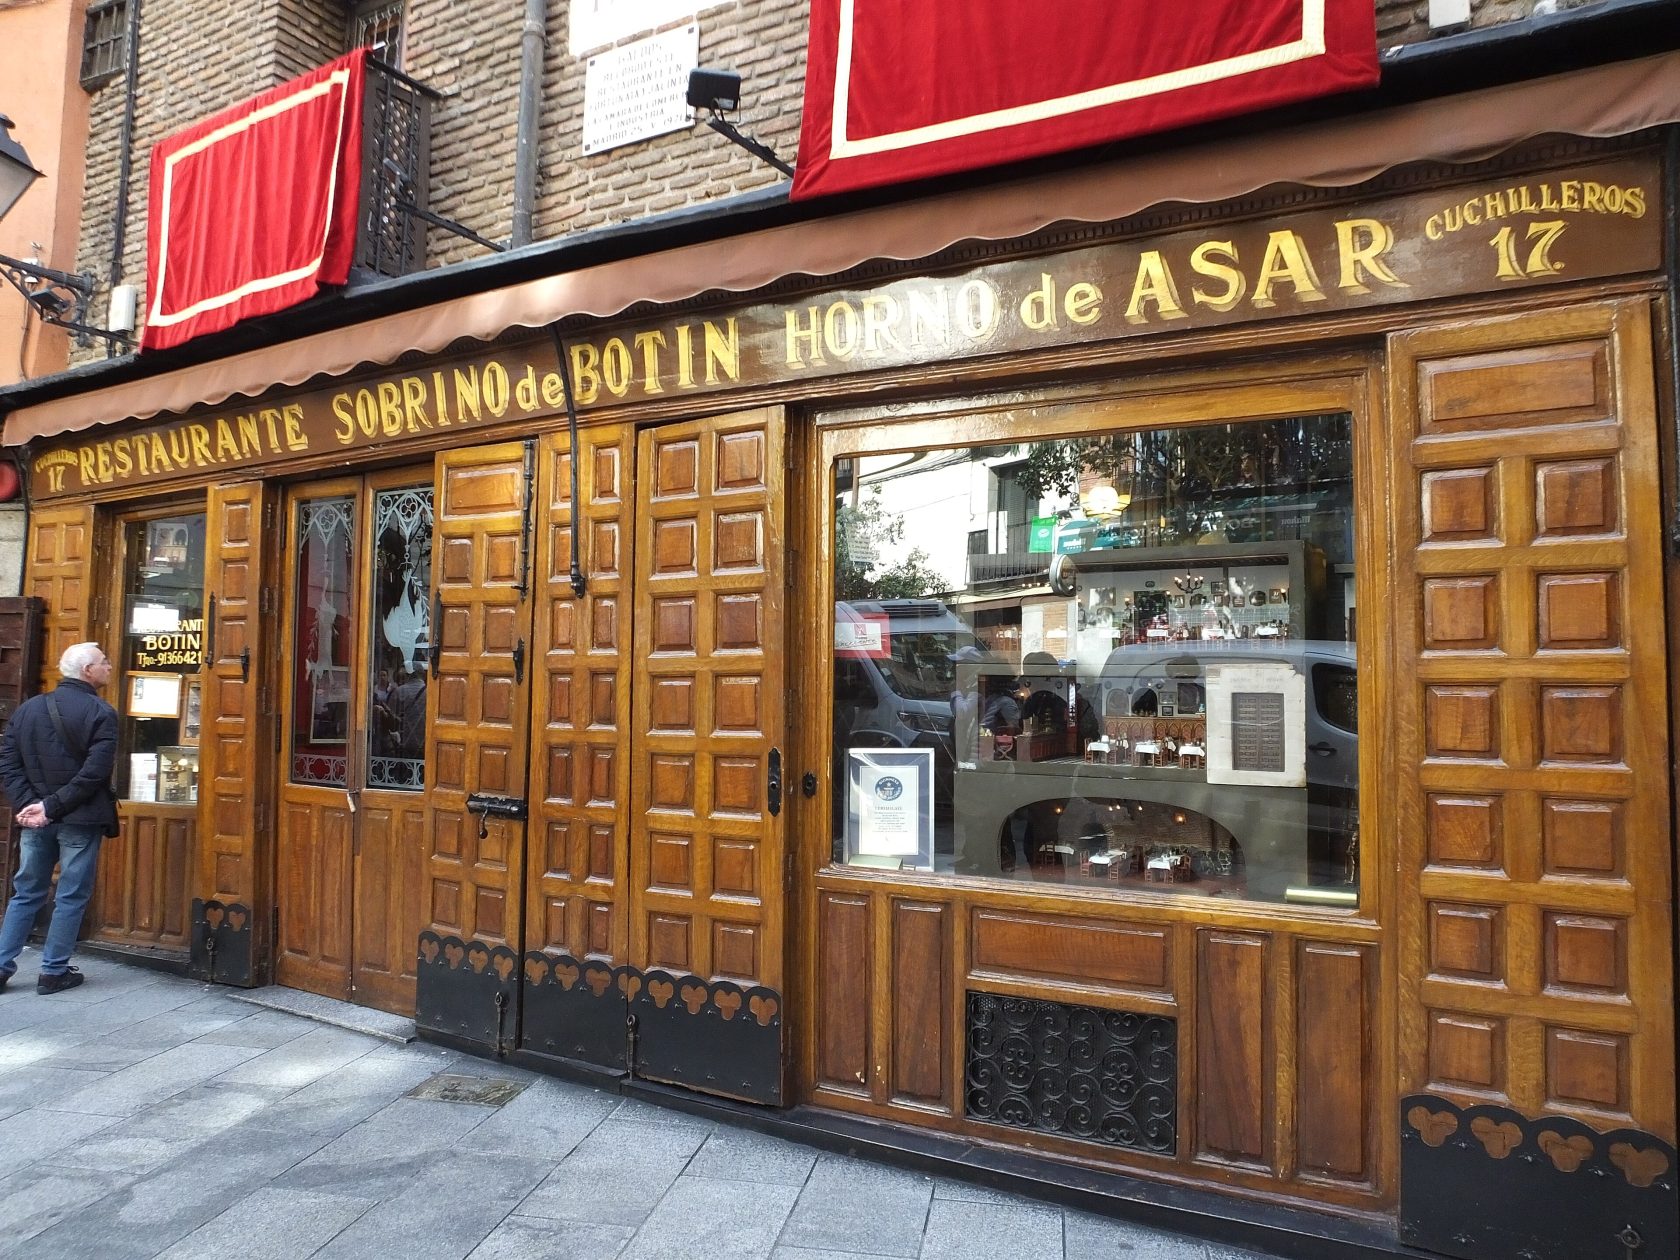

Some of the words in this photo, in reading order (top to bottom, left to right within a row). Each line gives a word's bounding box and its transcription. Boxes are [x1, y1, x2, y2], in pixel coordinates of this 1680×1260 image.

[1424, 180, 1647, 240] CUCHILLEROS
[79, 403, 309, 486] RESTAURANTE
[332, 361, 510, 445] SOBRINO
[515, 365, 564, 412] de
[570, 316, 741, 406] BOTIN
[783, 279, 1000, 370] HORNO
[1019, 272, 1101, 330] de
[1124, 218, 1412, 325] ASAR
[145, 633, 200, 650] BOTIN
